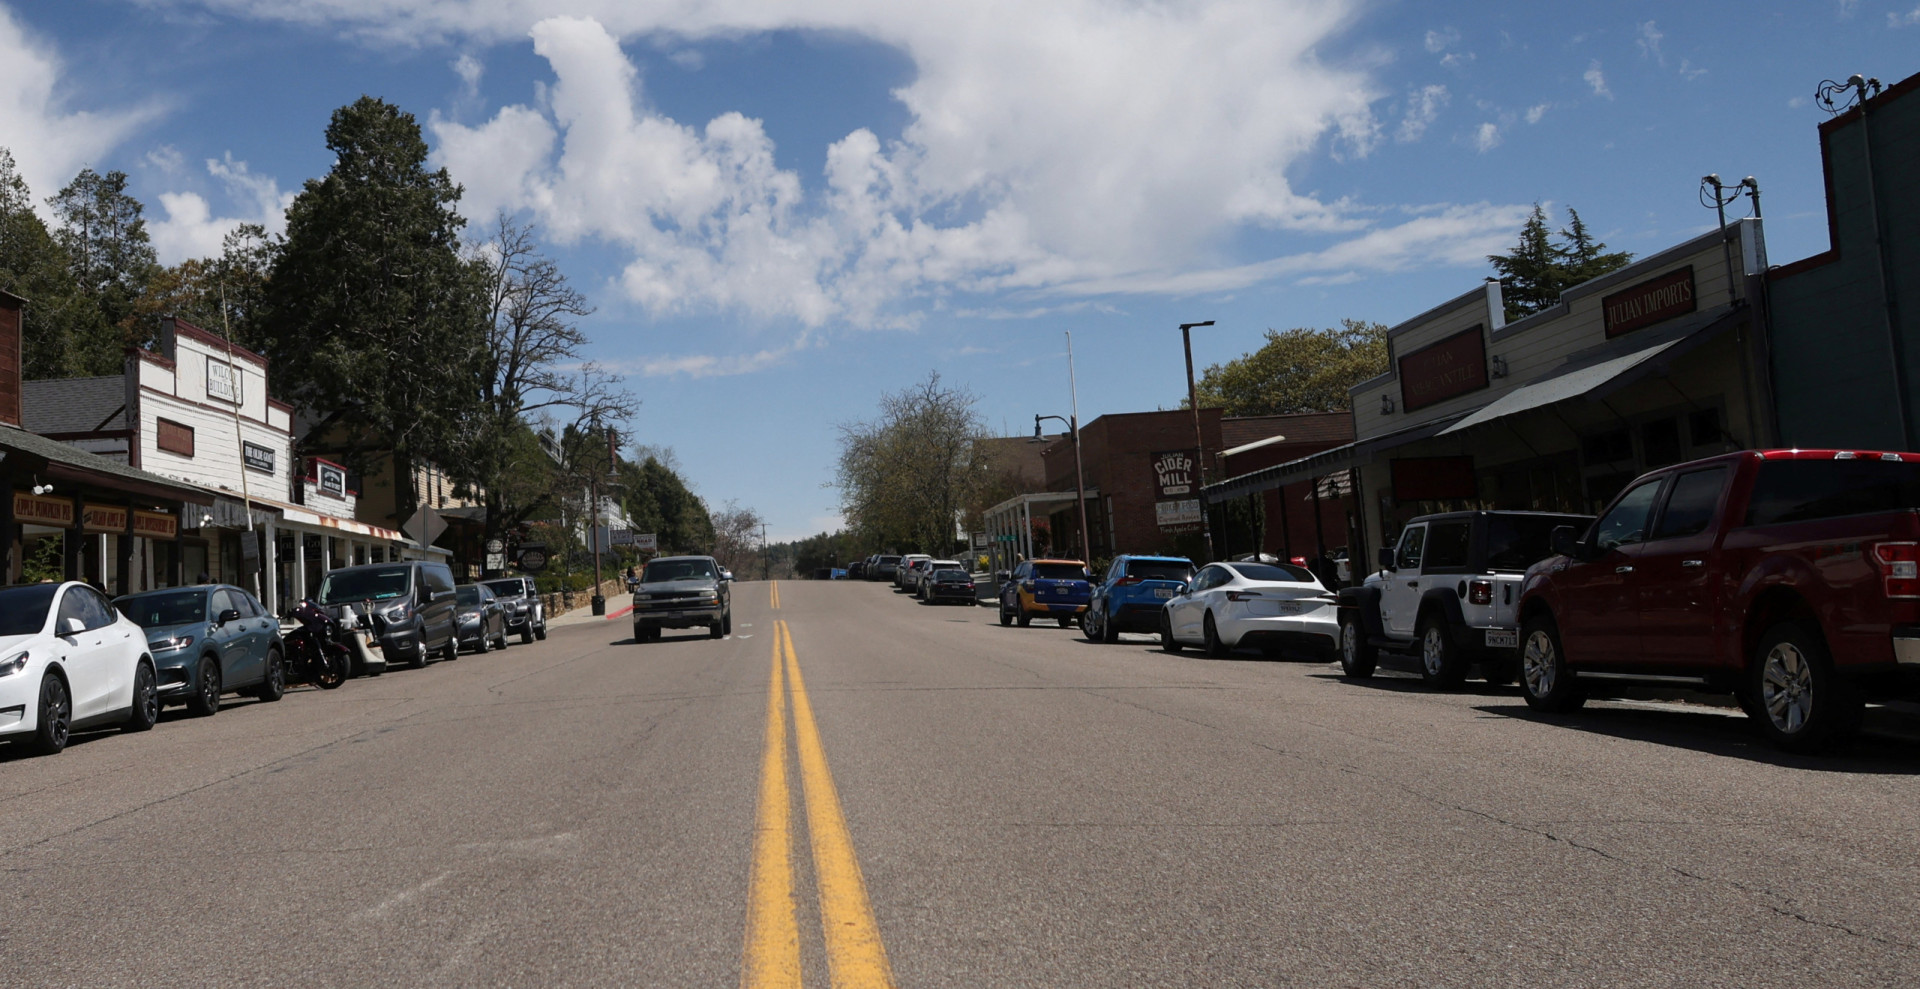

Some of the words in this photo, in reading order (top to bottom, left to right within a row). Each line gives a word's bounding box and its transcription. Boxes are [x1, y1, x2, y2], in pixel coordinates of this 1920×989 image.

[1608, 296, 1642, 330] JULIAN
[1643, 279, 1692, 315] IMPORTS
[209, 379, 240, 399] BUILDIG
[245, 446, 253, 457] THE
[252, 448, 263, 461] OLDE
[1161, 452, 1184, 460] JULIAN
[1154, 457, 1192, 474] CIDER
[1159, 472, 1192, 487] MILL
[15, 498, 34, 516] APPLE
[35, 500, 61, 520] PUMPKIN
[62, 504, 71, 521] PIE
